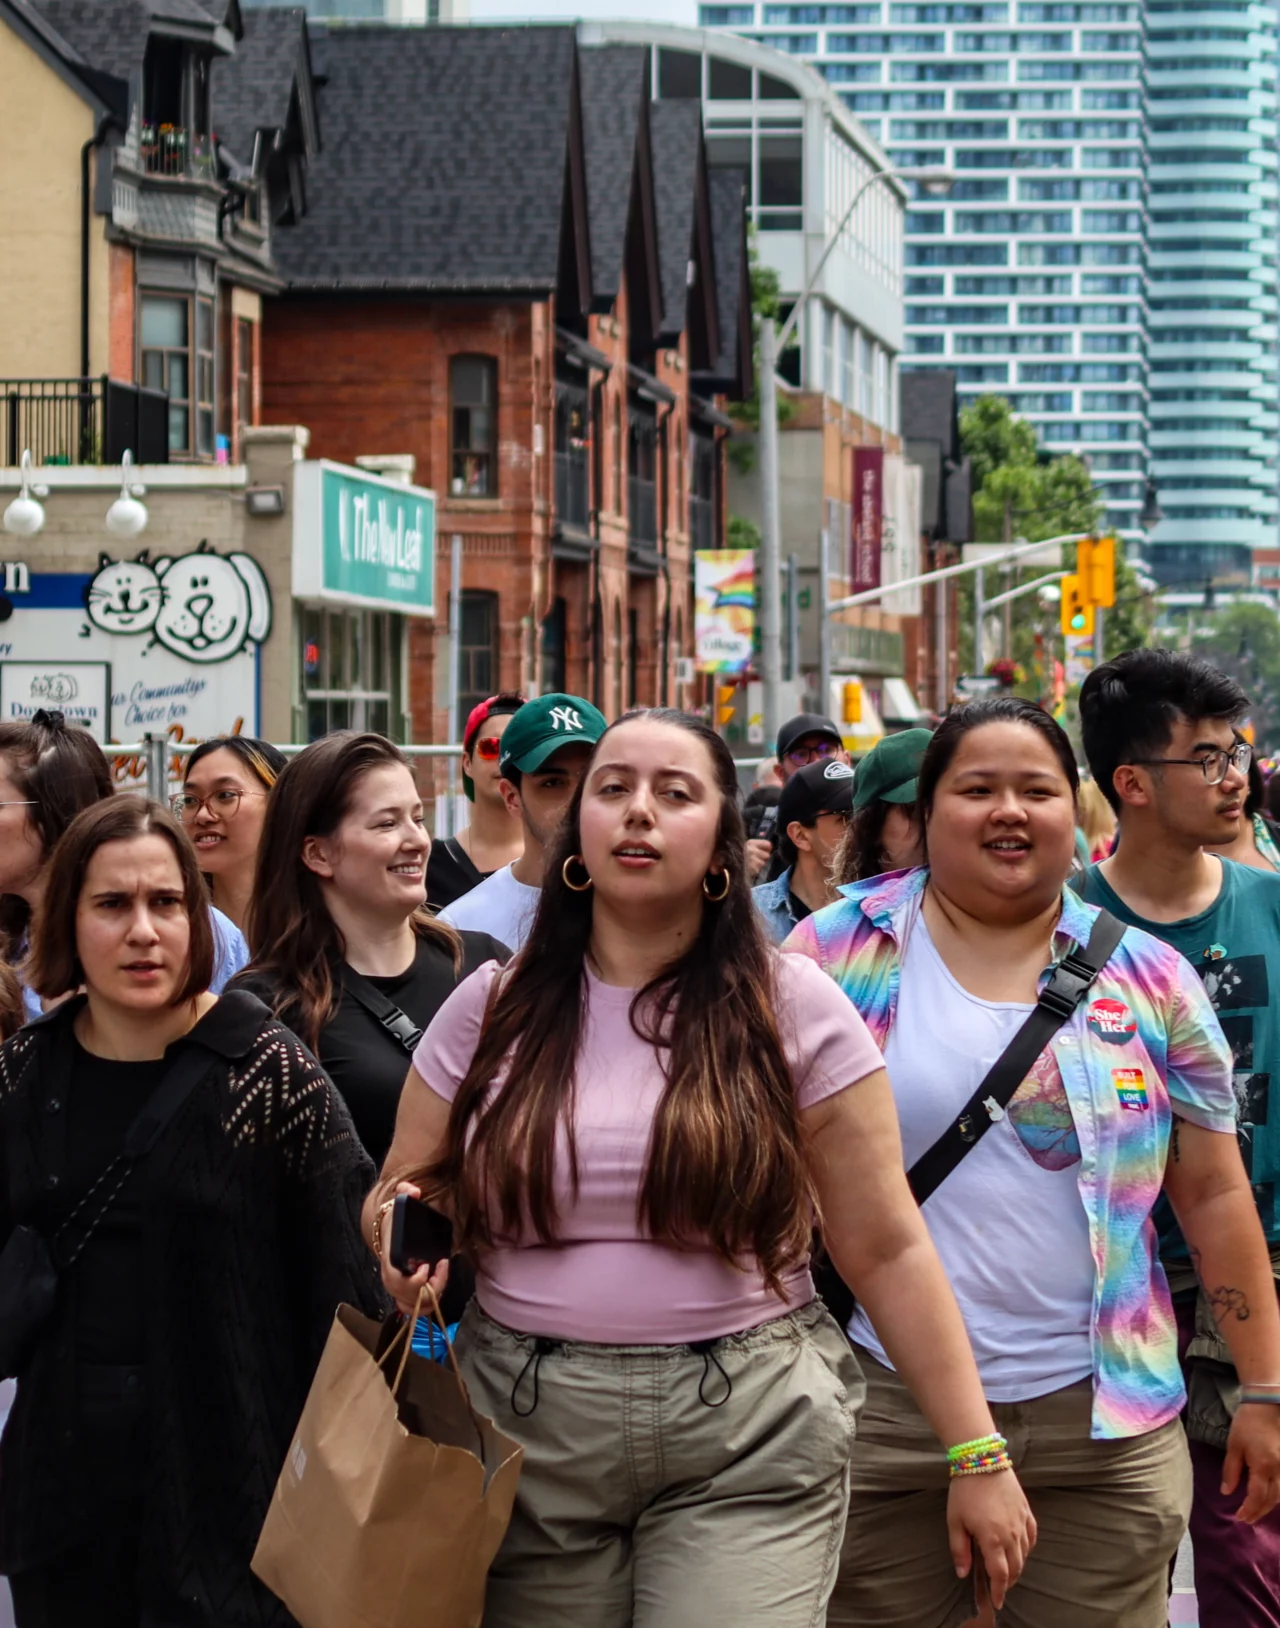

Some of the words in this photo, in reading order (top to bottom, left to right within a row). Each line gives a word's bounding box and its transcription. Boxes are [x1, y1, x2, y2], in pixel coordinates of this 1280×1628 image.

[353, 493, 378, 563] The
[398, 506, 422, 572] Leaf
[0, 562, 31, 592] n
[125, 703, 166, 727] Choice
[549, 706, 583, 731] NY
[1094, 1008, 1127, 1021] She/
[1100, 1020, 1127, 1033] Her
[1123, 1093, 1141, 1102] LOVE
